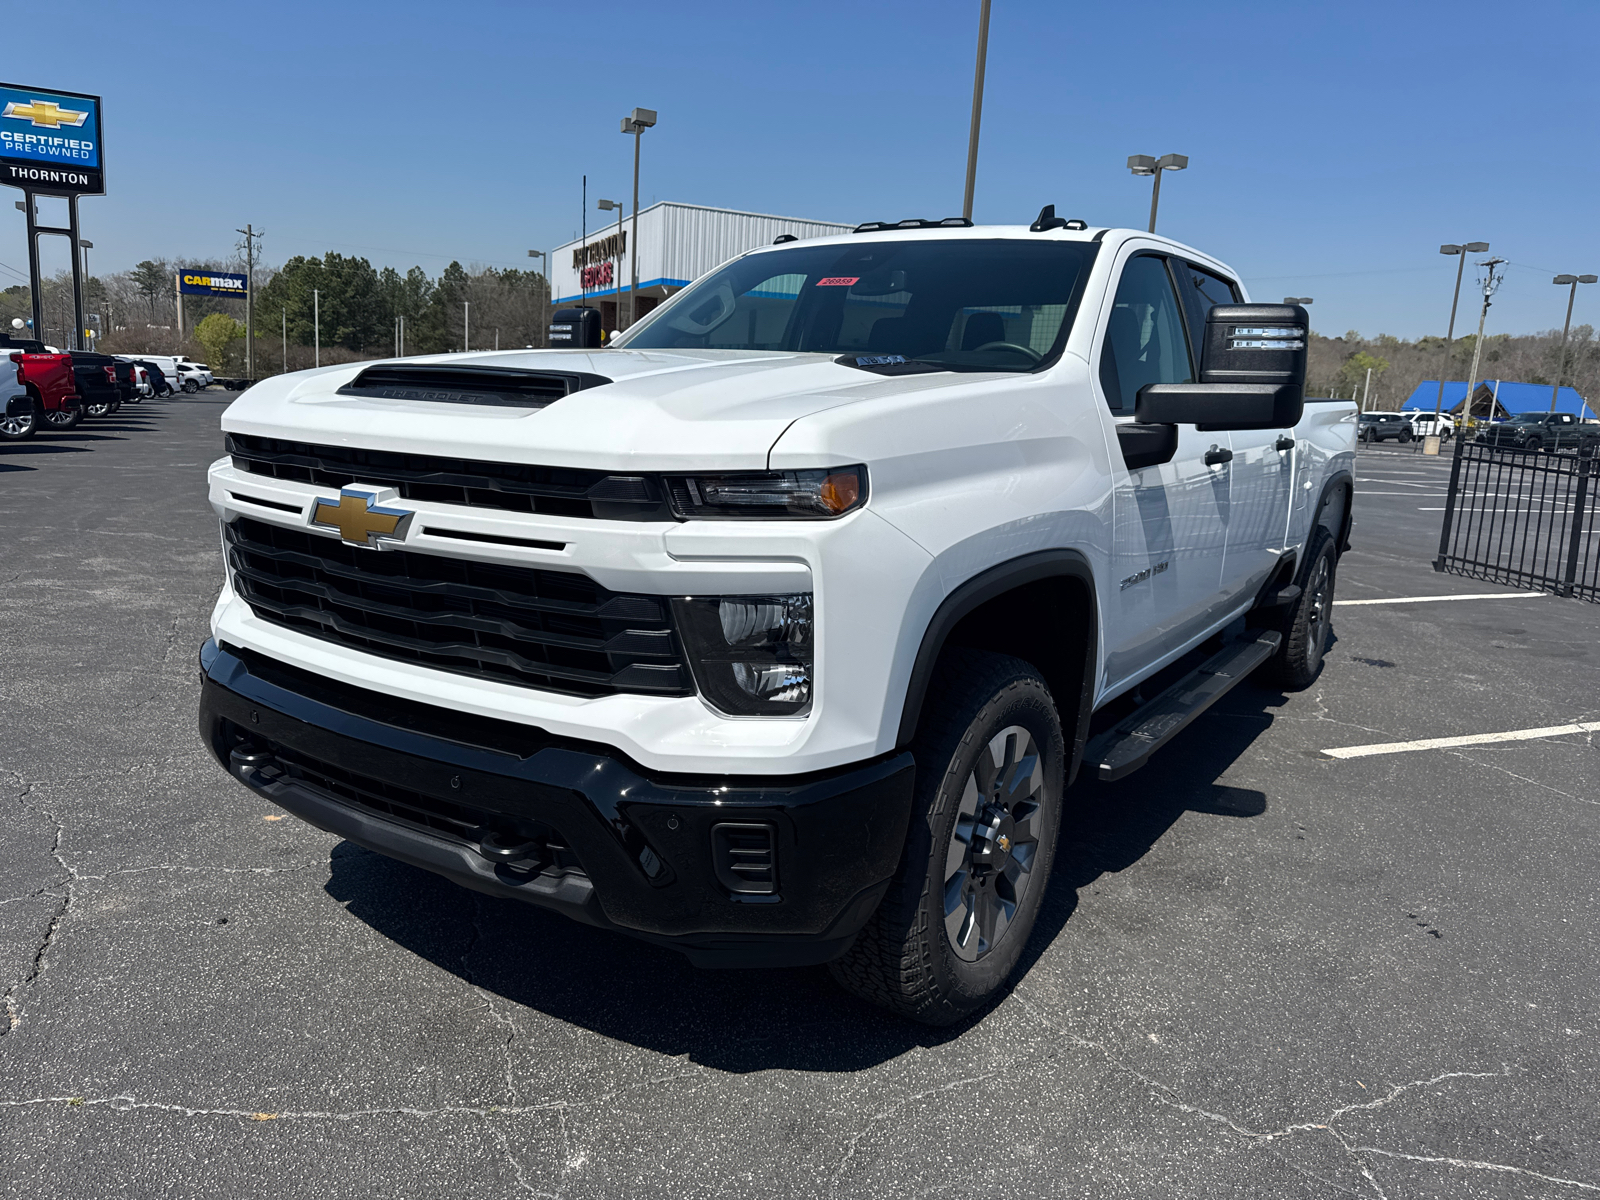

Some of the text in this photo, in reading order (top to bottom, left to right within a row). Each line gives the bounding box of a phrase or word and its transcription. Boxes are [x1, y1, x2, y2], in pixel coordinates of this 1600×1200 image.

[0, 131, 93, 150] CERTIFIED
[5, 141, 89, 159] PRE-OWNED
[9, 166, 88, 185] THORNTON
[594, 261, 612, 285] CARS
[382, 390, 483, 402] CHEVROLET
